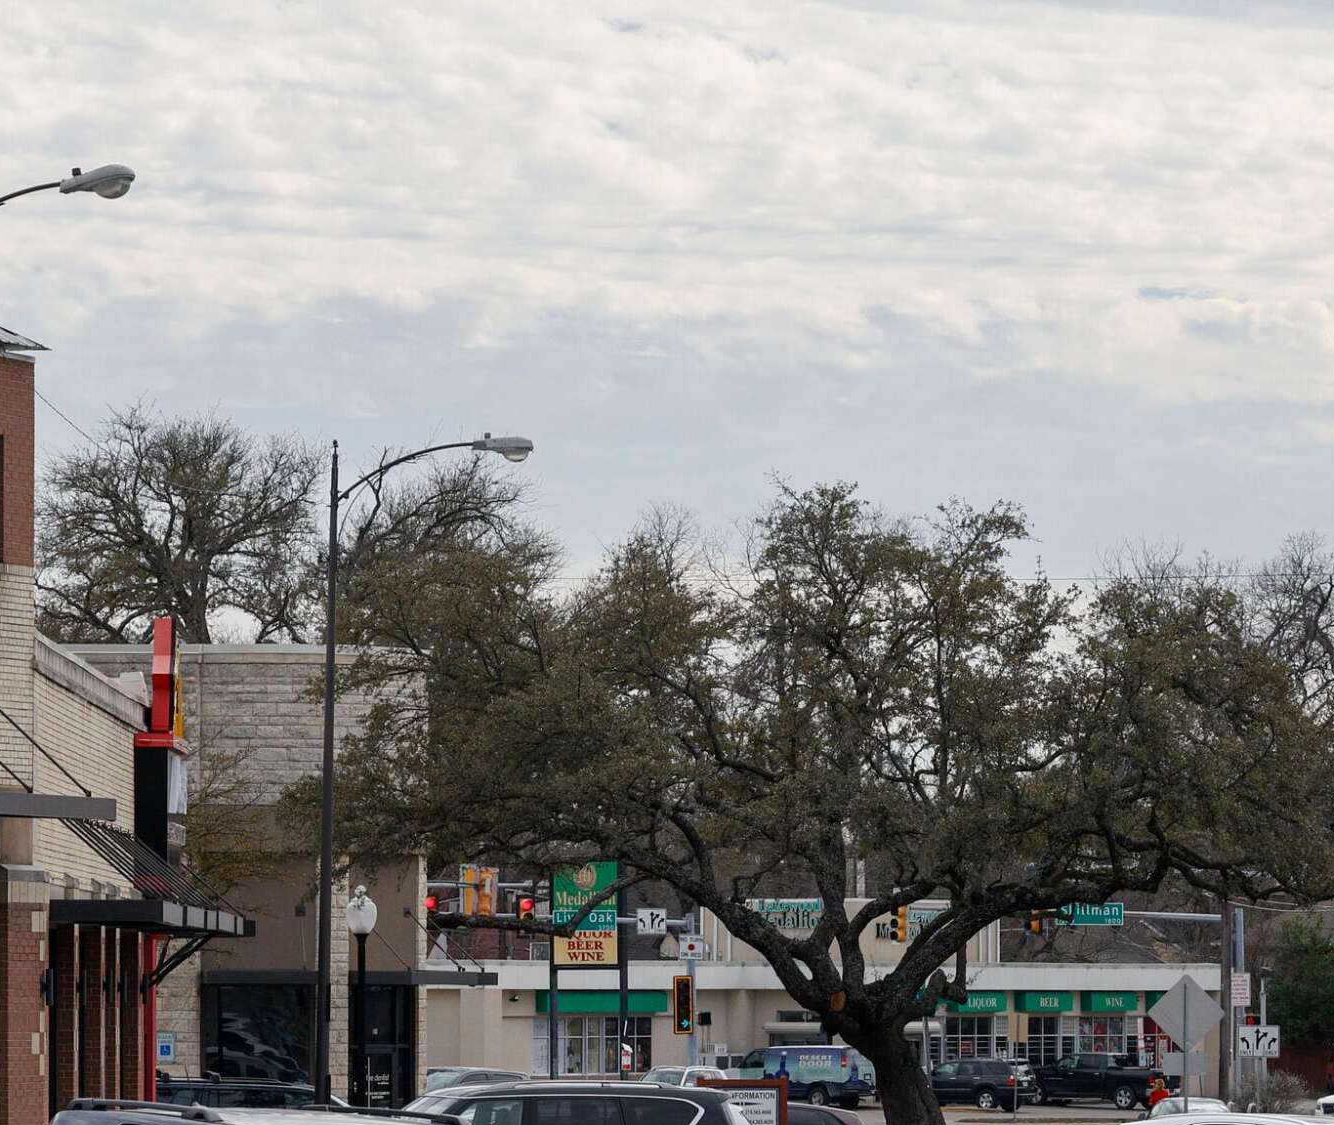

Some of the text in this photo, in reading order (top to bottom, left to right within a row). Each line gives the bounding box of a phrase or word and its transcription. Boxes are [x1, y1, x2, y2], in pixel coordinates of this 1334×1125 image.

[589, 912, 613, 923] Oak
[567, 941, 604, 951] BEER
[567, 952, 605, 961] WINE
[968, 997, 997, 1008] LIQUOR
[1040, 997, 1059, 1008] BEER
[1105, 997, 1124, 1007] WINE
